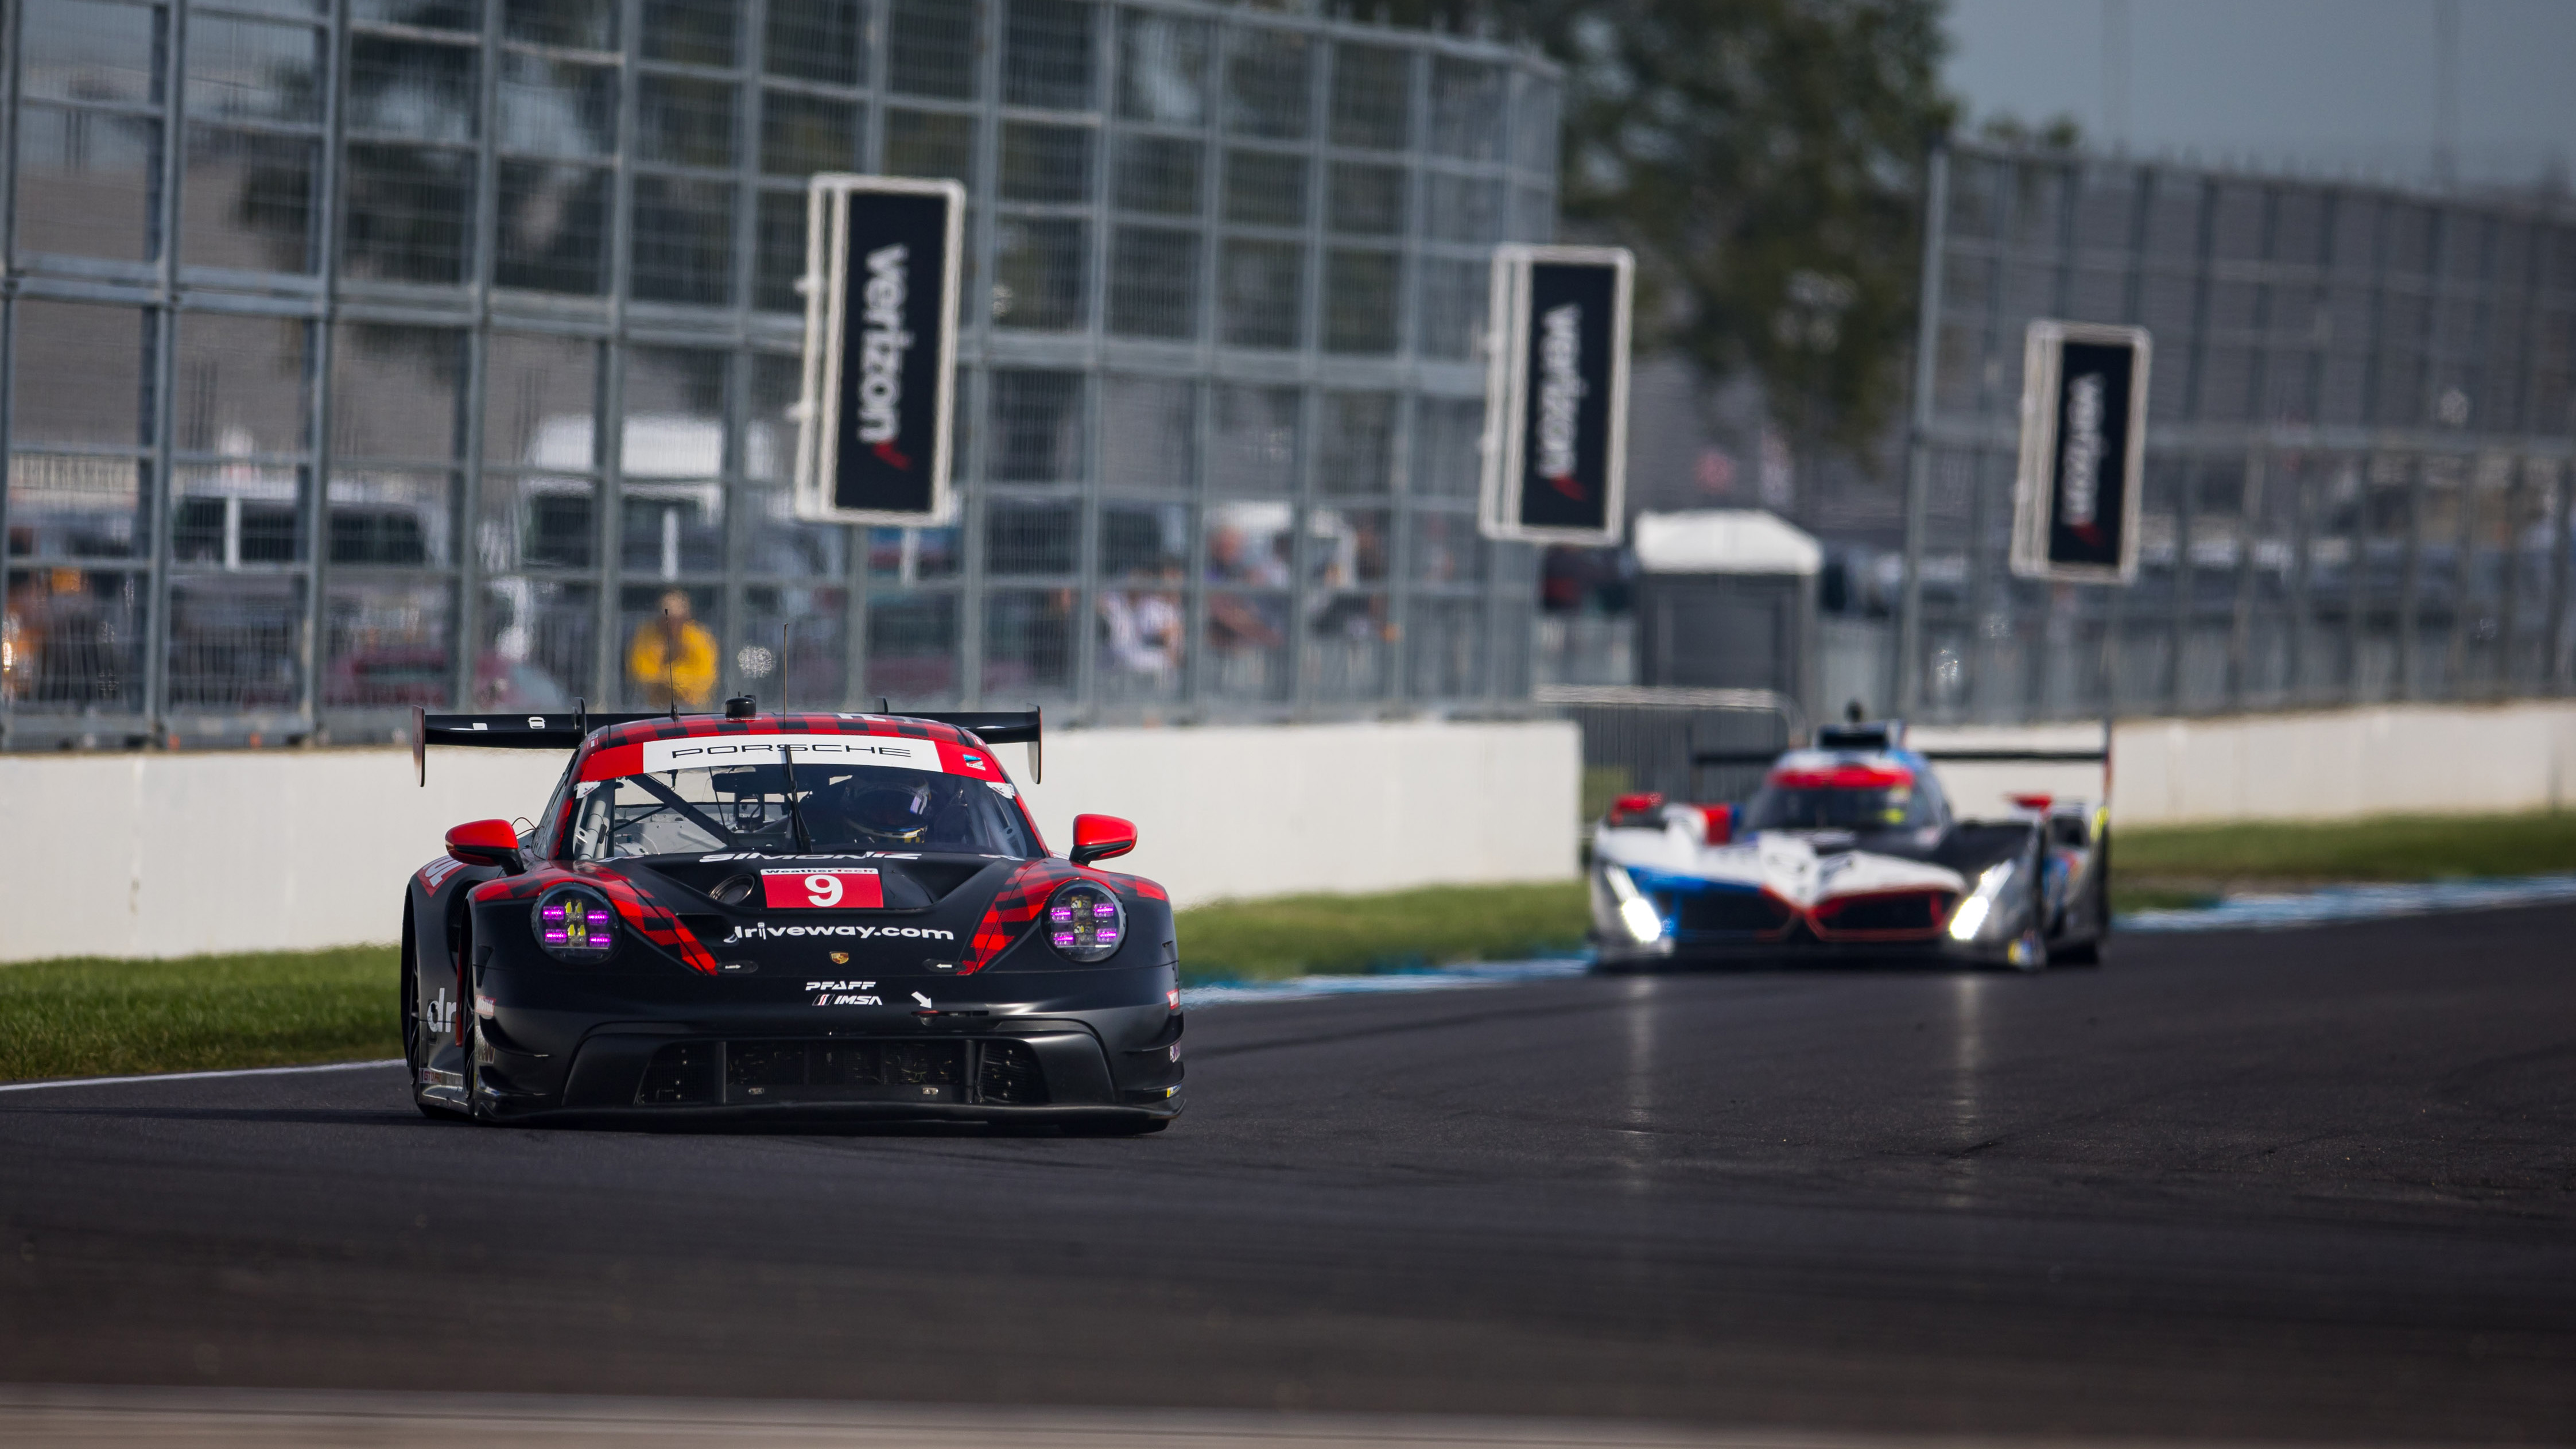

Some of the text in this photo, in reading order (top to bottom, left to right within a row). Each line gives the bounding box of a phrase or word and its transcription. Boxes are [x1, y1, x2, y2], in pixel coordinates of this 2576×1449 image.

[858, 242, 915, 443] verizon
[1535, 302, 1589, 479] verizon
[672, 743, 911, 758] PORSCHE
[804, 874, 843, 907] 9
[723, 922, 954, 943] driveway.com
[805, 981, 876, 991] PFAFF
[834, 995, 883, 1006] IMSA
